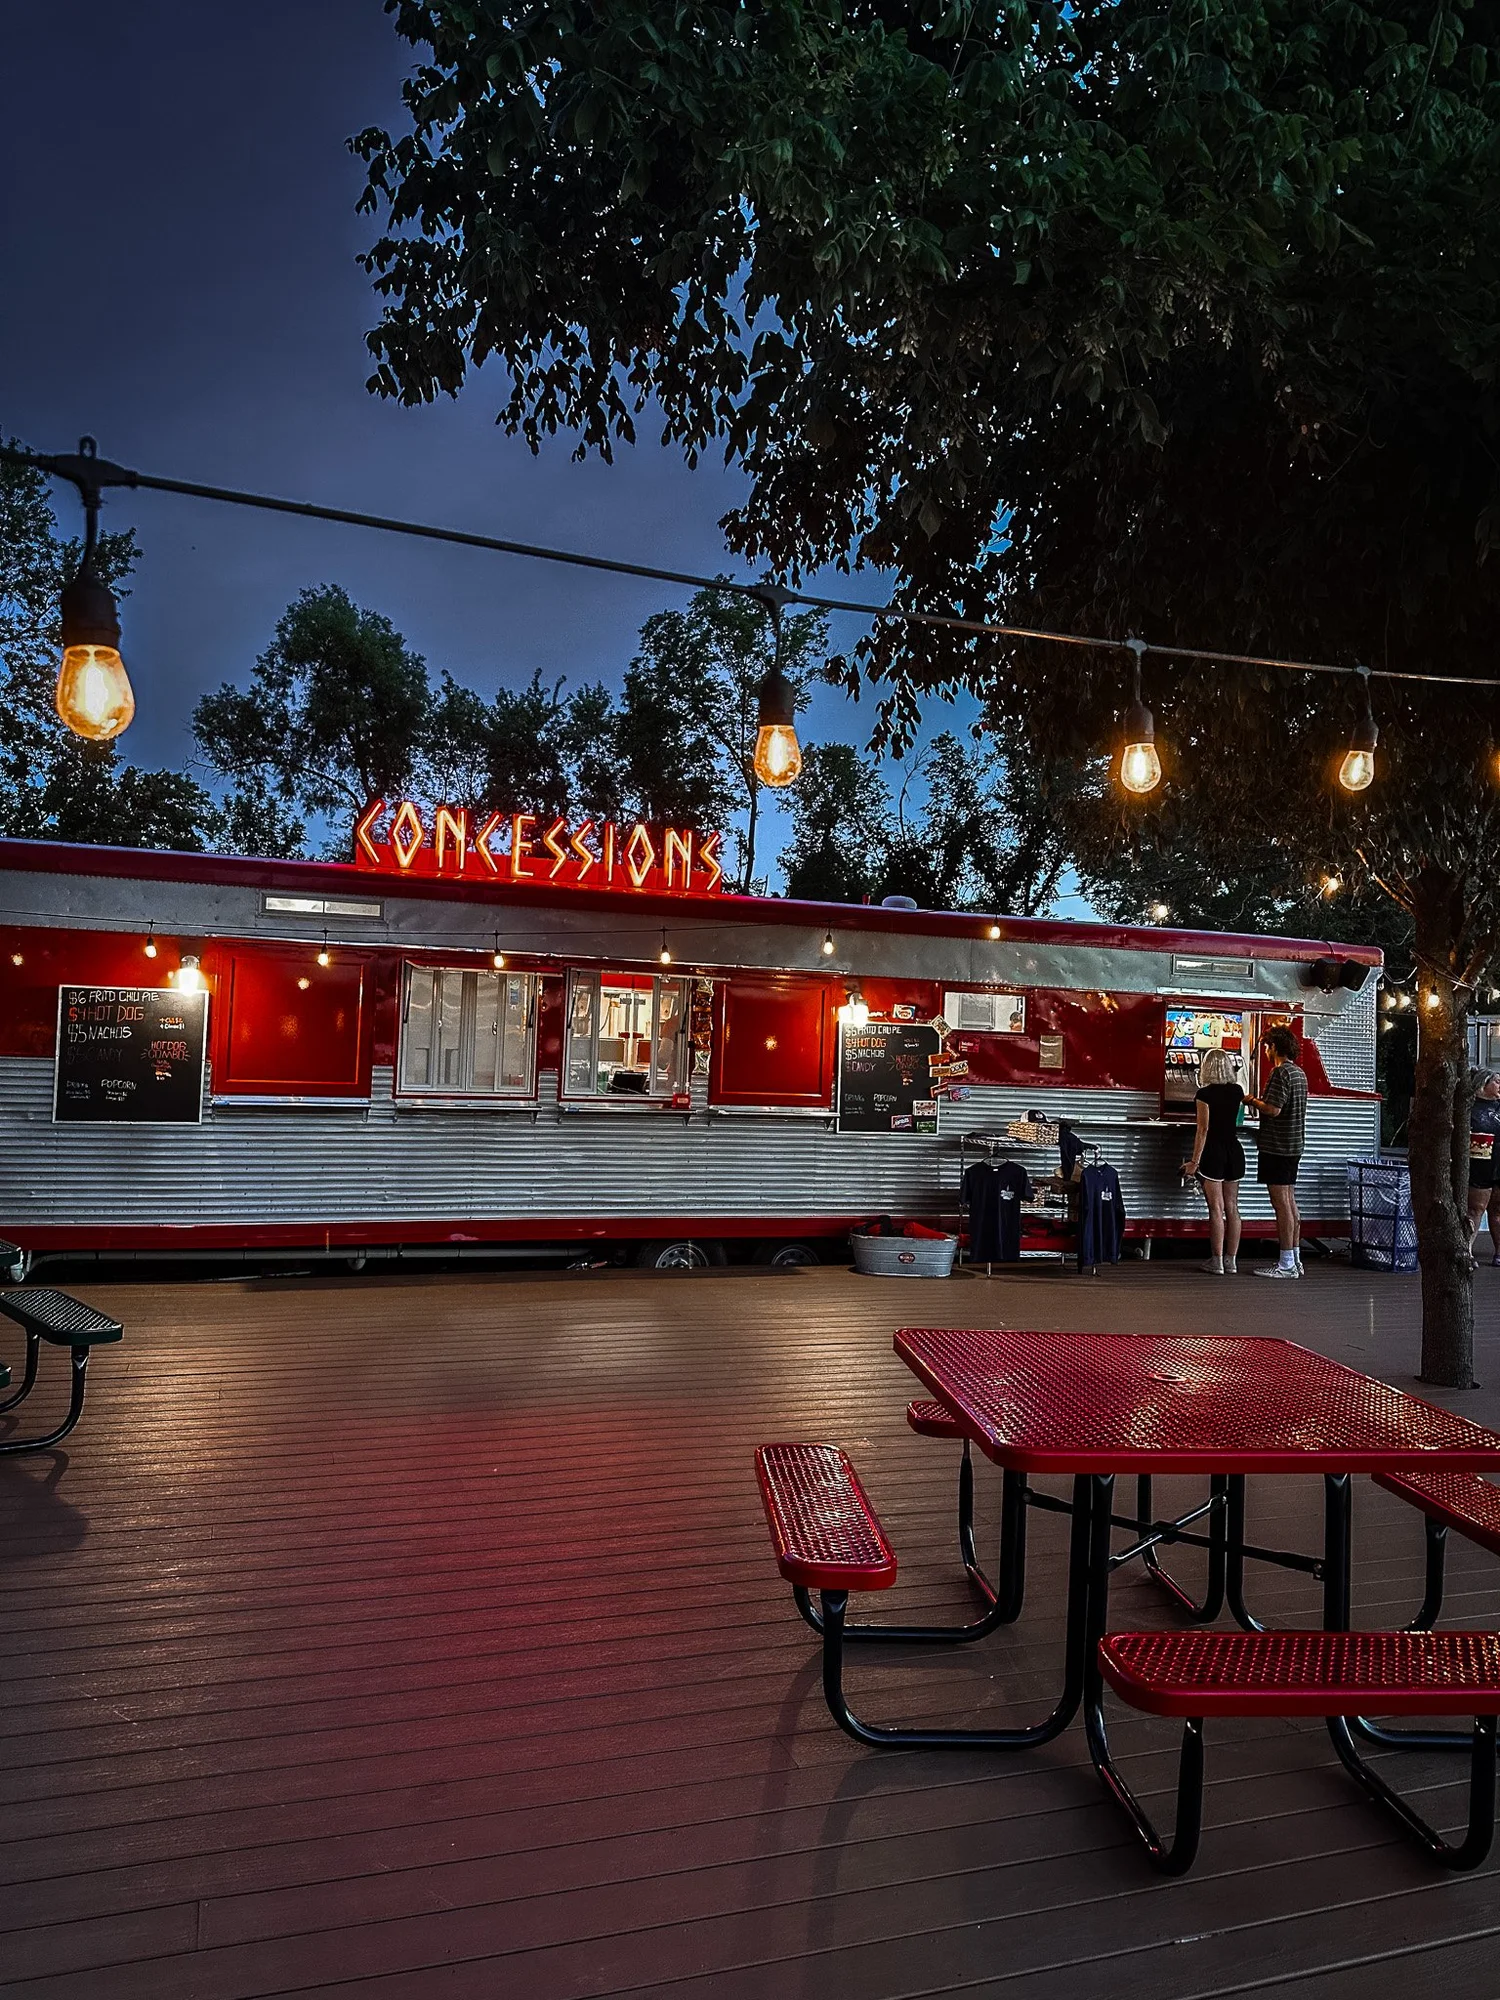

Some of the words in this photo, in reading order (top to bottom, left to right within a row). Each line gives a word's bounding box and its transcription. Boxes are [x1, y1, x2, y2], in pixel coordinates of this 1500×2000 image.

[356, 798, 724, 891] CONCESSIONS
[141, 991, 160, 1002] PIE
[87, 1005, 114, 1021] HOT
[116, 1005, 145, 1023] DOG
[88, 1025, 133, 1040] NACHOS
[857, 1037, 871, 1048] HOT
[871, 1037, 888, 1048] DOG
[845, 1049, 858, 1060] $5
[858, 1048, 886, 1059] NACHOS
[852, 1061, 877, 1072] CANDY
[100, 1078, 138, 1090] POPCORN
